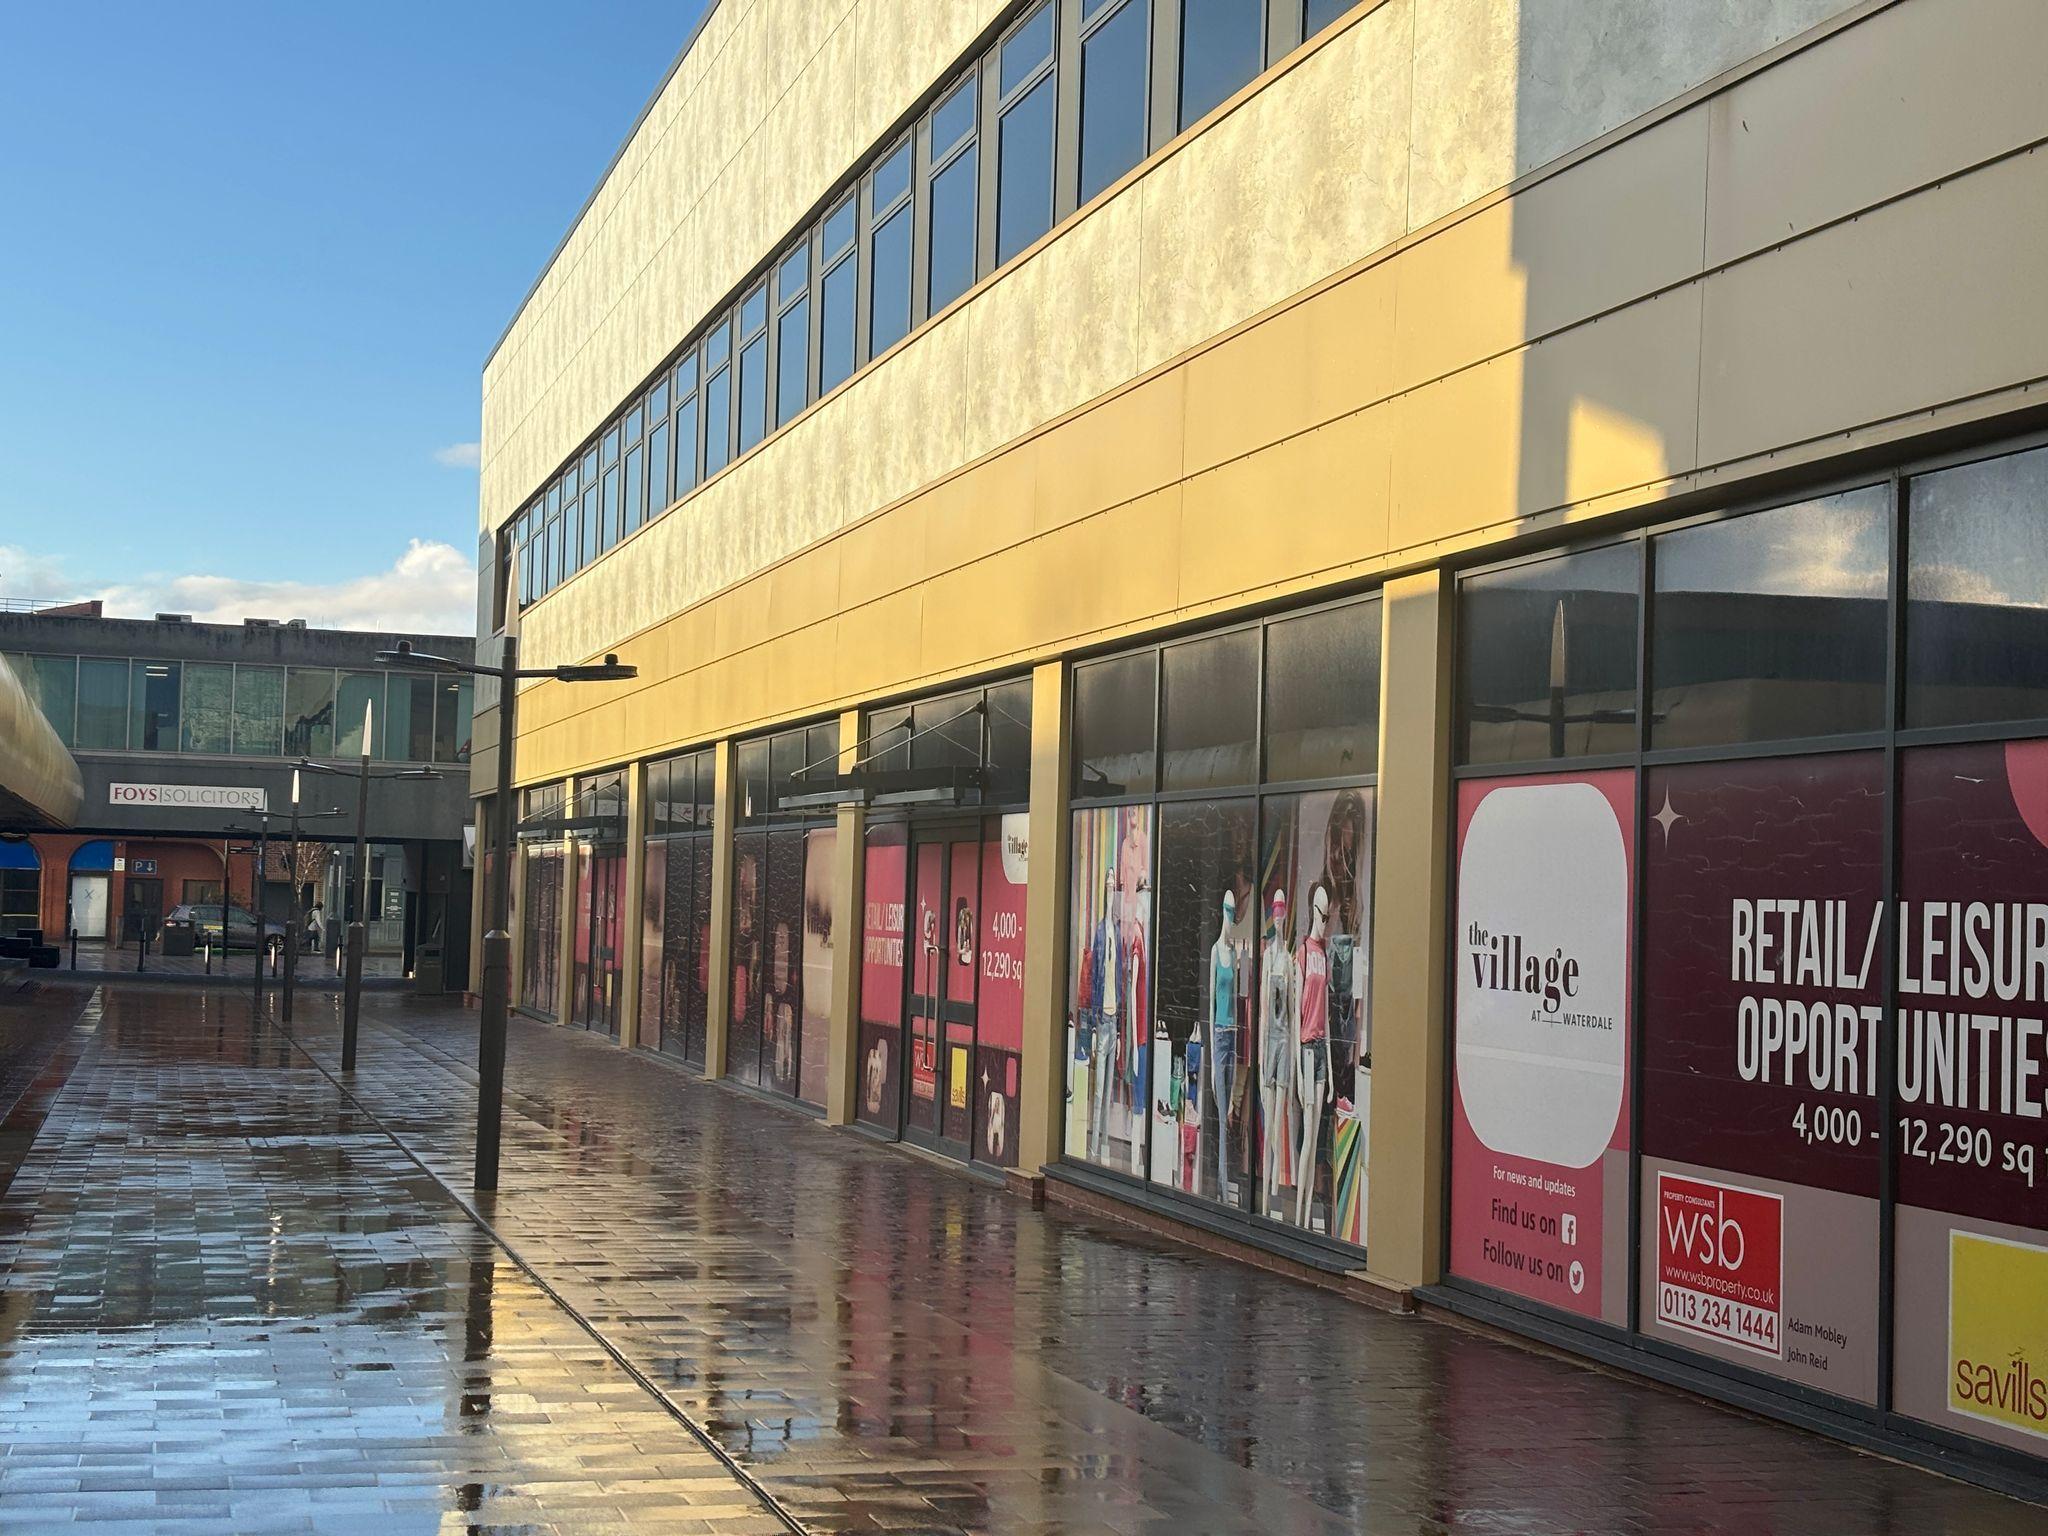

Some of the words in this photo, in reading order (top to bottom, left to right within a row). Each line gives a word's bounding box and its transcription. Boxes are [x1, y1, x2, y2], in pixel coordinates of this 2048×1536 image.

[114, 787, 157, 802] FOYS
[164, 788, 260, 805] SOLICITORS
[135, 861, 142, 870] P
[992, 912, 1017, 942] 4,000
[1468, 921, 1488, 946] the
[1732, 898, 1884, 990] RETAIL/
[982, 950, 1010, 981] 12,290
[1012, 960, 1022, 989] sq
[1471, 935, 1579, 1014] village
[1531, 1010, 1541, 1022] AT
[1563, 1013, 1613, 1031] WATERDALE
[1791, 1102, 1862, 1146] 4,000
[1898, 1117, 1992, 1168] 12,290
[2002, 1142, 2034, 1188] sq
[1493, 1165, 1505, 1180] For
[1506, 1171, 1526, 1186] news
[1528, 1174, 1542, 1189] and
[1544, 1178, 1576, 1198] updates
[1663, 1190, 1684, 1202] PROPERTY
[1492, 1198, 1518, 1226] Find
[1521, 1210, 1536, 1231] us
[1540, 1215, 1556, 1236] on
[1664, 1190, 1745, 1271] wsb
[1483, 1238, 1525, 1271] Follow
[1528, 1256, 1543, 1276] us
[1546, 1261, 1563, 1283] on
[1665, 1265, 1775, 1305] www.wsbproperty.co.uk
[1664, 1288, 1697, 1321] 0113
[1701, 1298, 1731, 1331] 234
[1736, 1307, 1774, 1343] 1444
[1788, 1317, 1813, 1337] Adam
[1815, 1324, 1847, 1350] Mobley
[1787, 1347, 1807, 1365] John
[1809, 1352, 1828, 1371] Reid
[1956, 1359, 2048, 1421] savills
